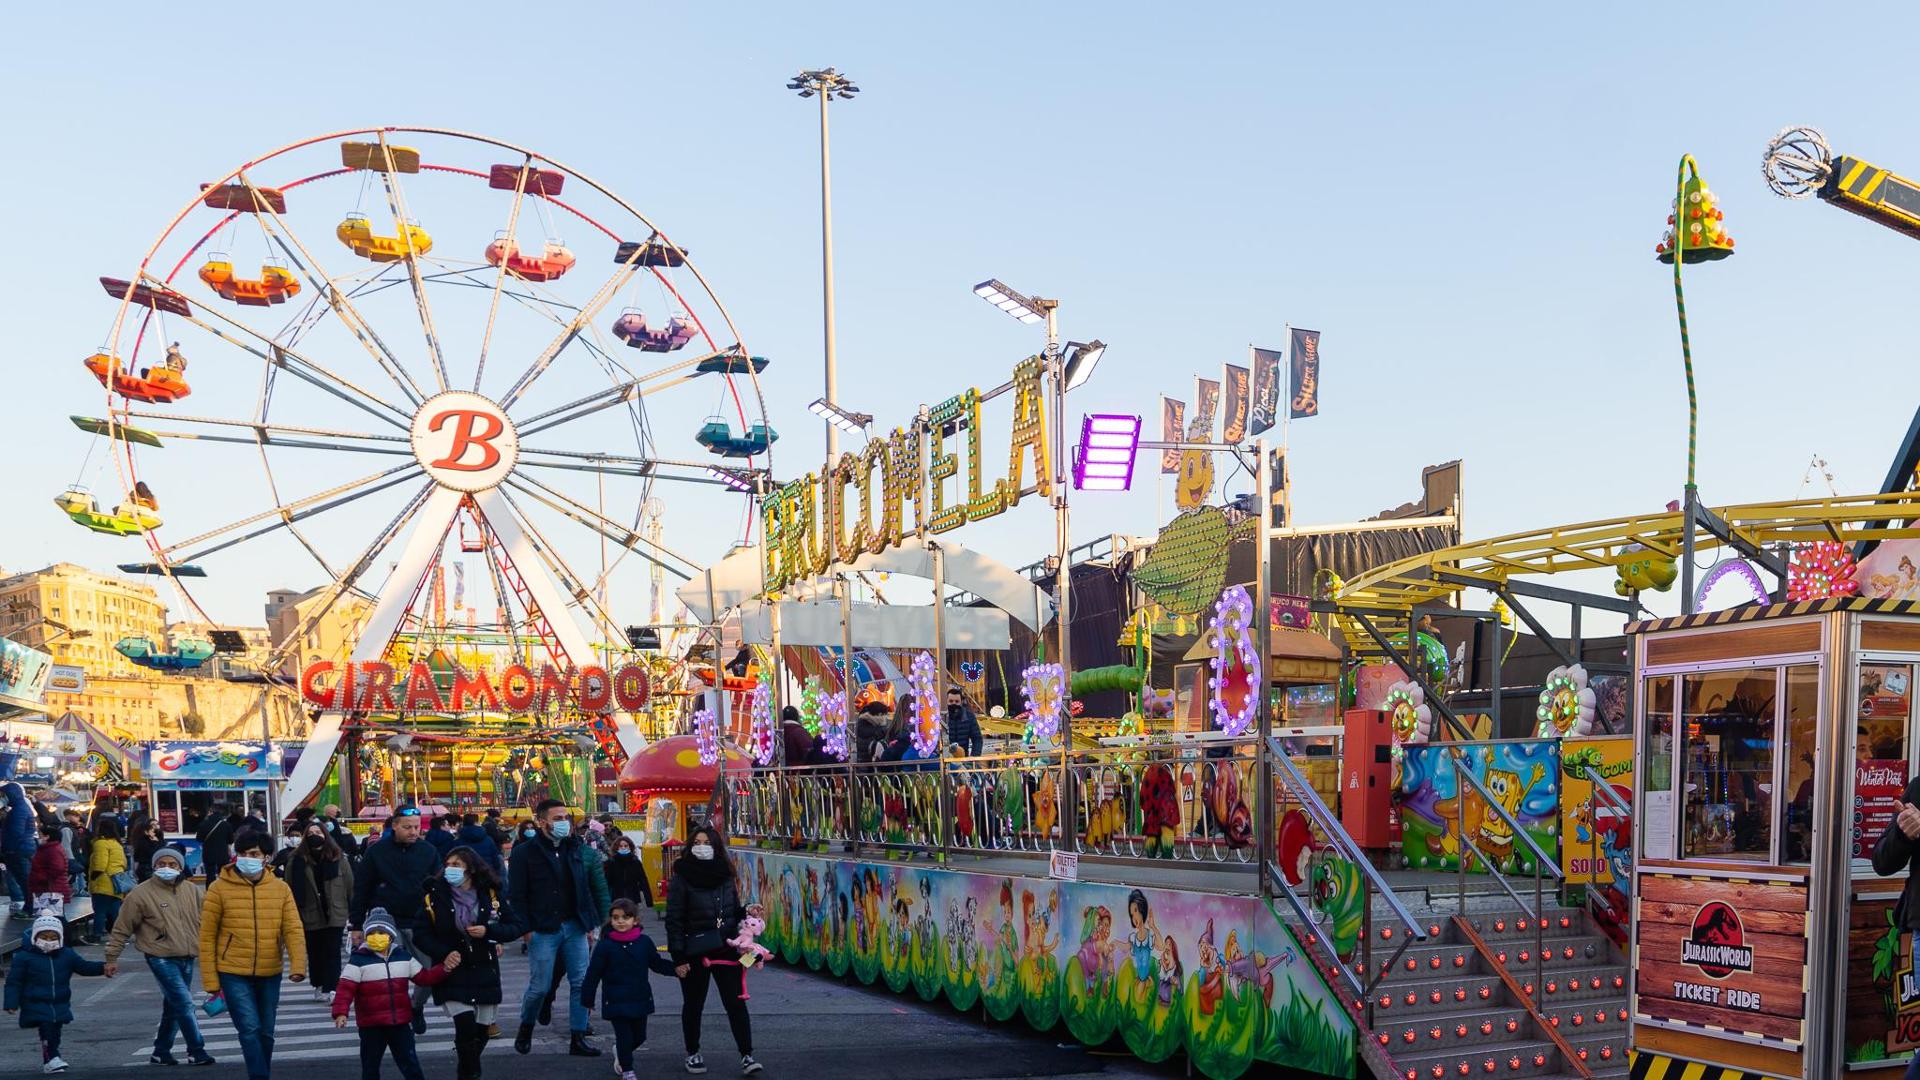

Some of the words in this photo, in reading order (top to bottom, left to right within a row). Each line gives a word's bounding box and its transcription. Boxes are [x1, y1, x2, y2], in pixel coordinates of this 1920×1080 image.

[428, 409, 504, 472] B
[763, 354, 1051, 594] BRUCOMELA
[302, 660, 652, 712] GIRAMONDO
[159, 750, 259, 773] CASSA
[1576, 760, 1633, 779] BUCOM
[1856, 767, 1885, 786] Winter
[1570, 858, 1606, 874] SOO
[1674, 982, 1720, 1003] TICKET
[1727, 989, 1760, 1010] RIDE
